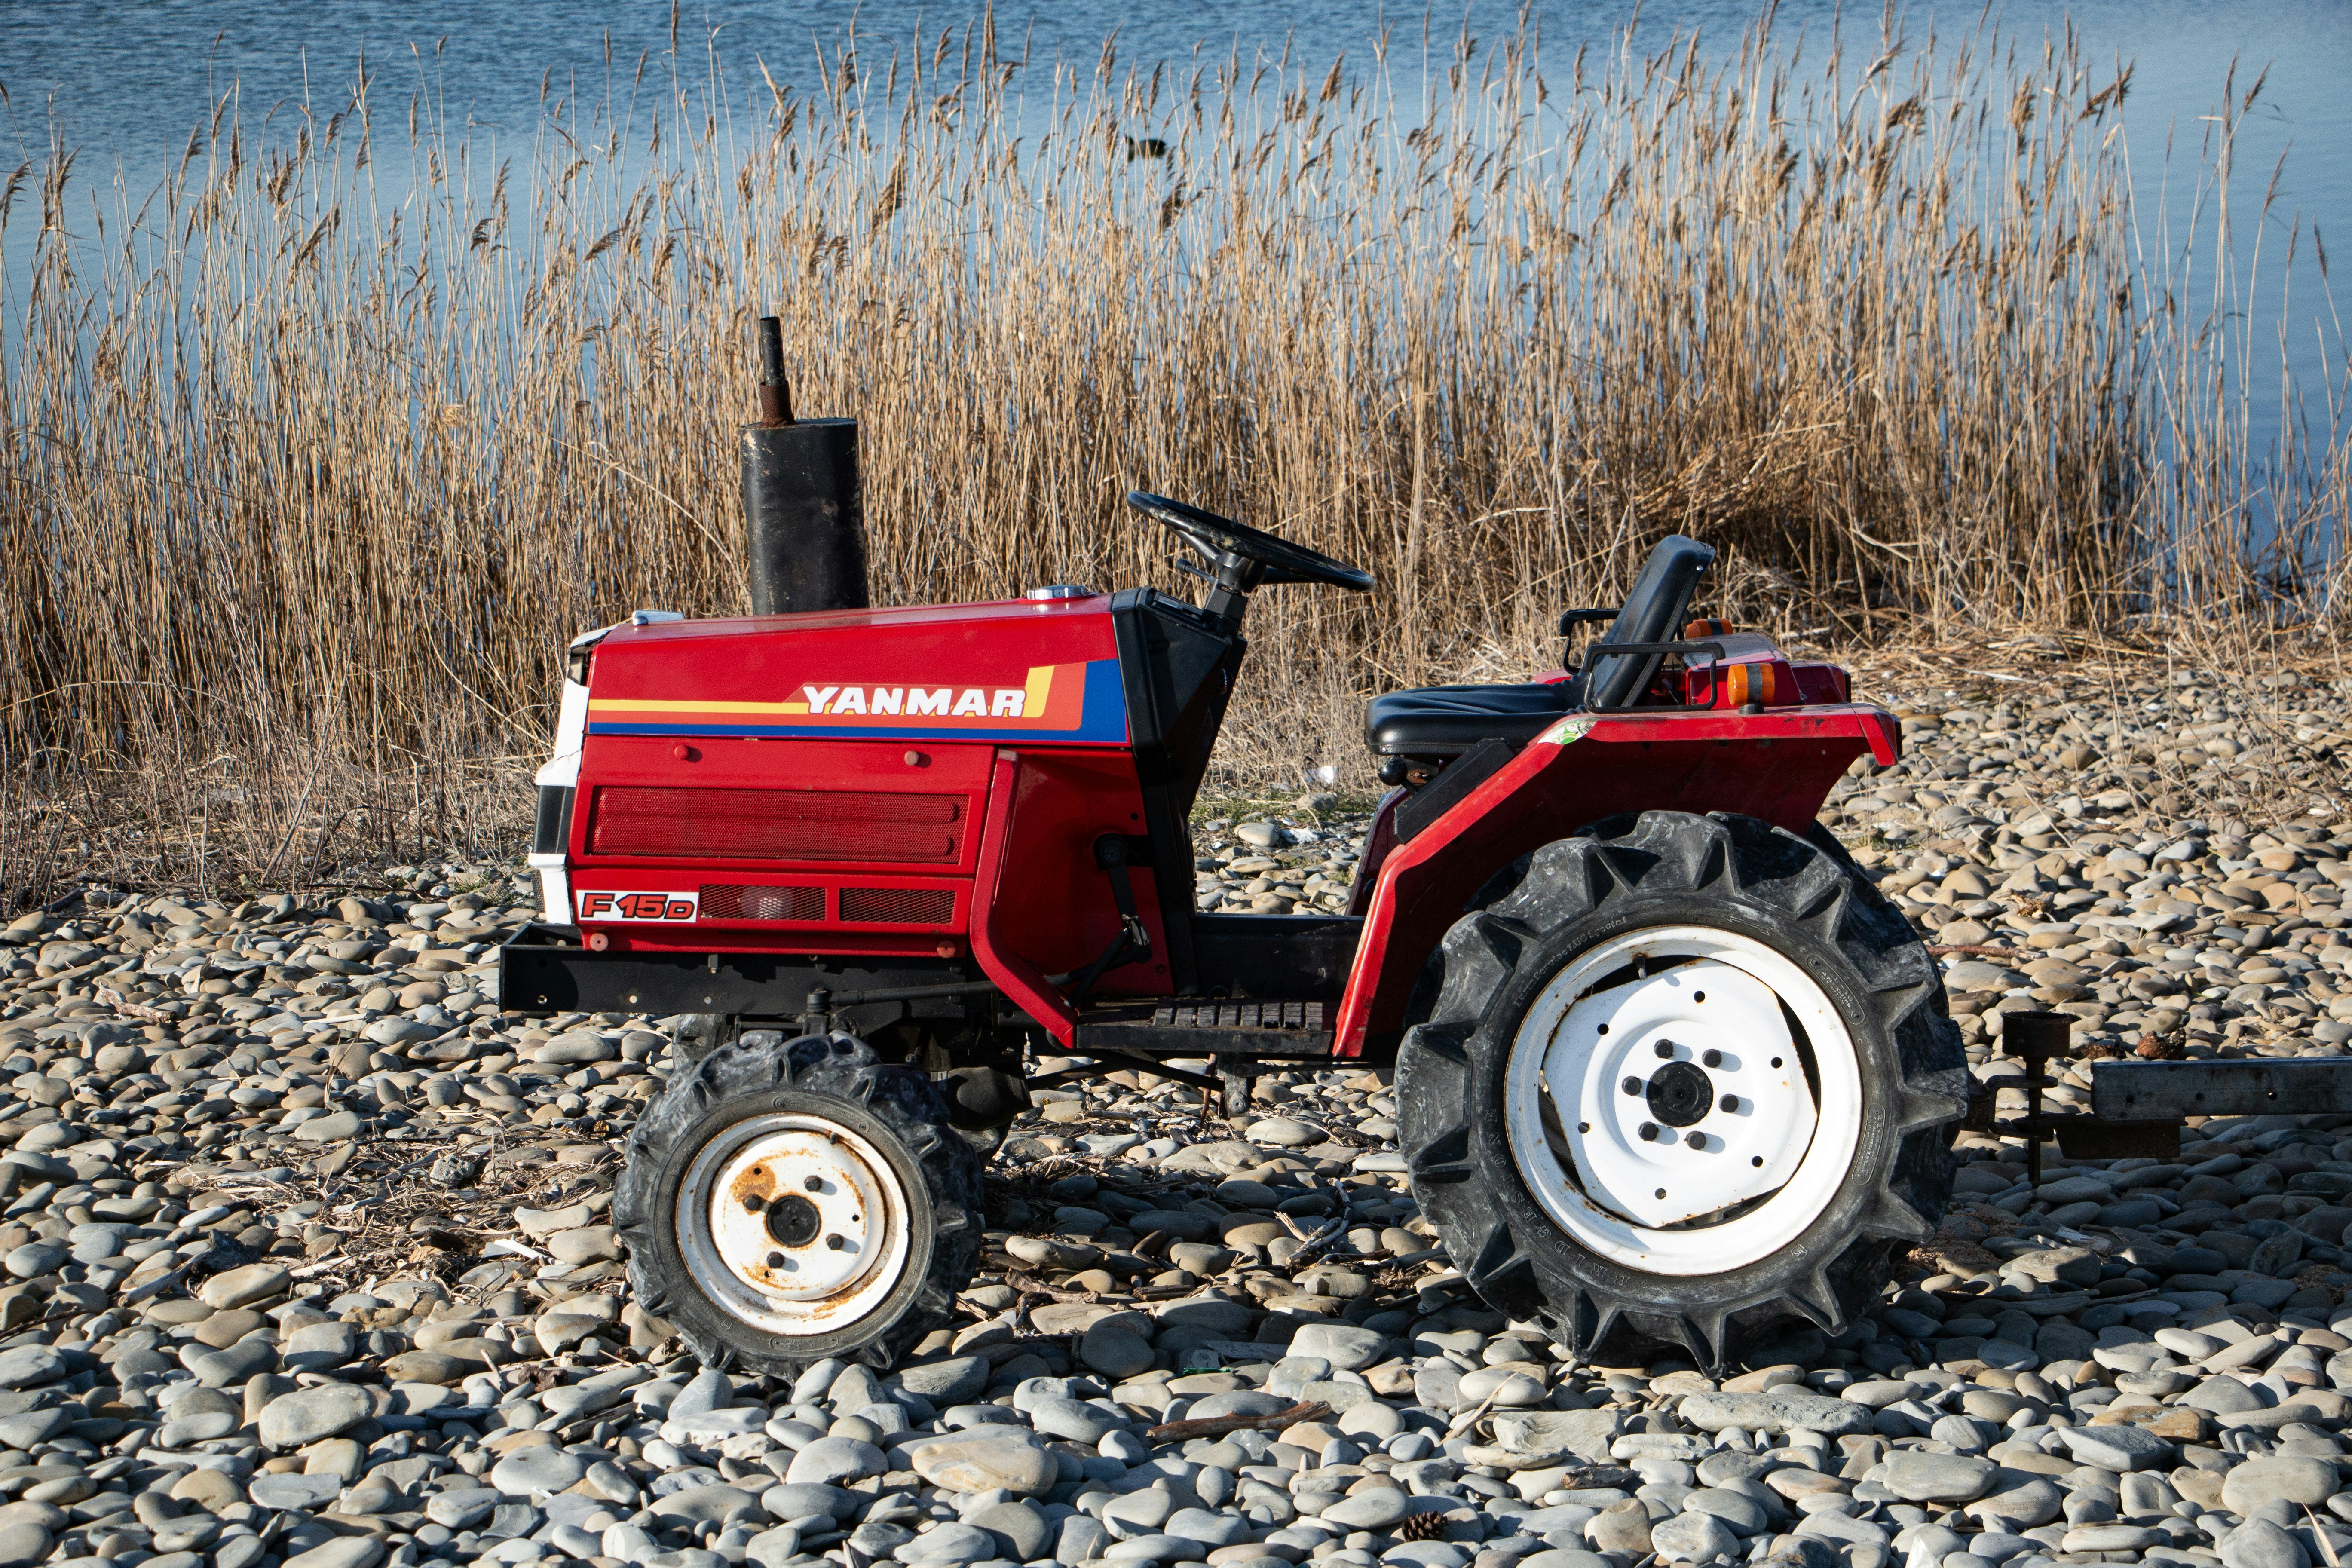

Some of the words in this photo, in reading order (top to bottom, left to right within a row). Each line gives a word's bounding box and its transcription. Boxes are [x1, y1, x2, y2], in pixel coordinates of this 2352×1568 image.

[803, 686, 1026, 717] YANMAR
[581, 892, 695, 920] F15D
[1513, 978, 1537, 1007] Farm
[1533, 948, 1568, 981] Service
[1566, 934, 1589, 952] LUG
[1587, 916, 1627, 939] Special
[1484, 1109, 1631, 1288] BRIDGESTONE
